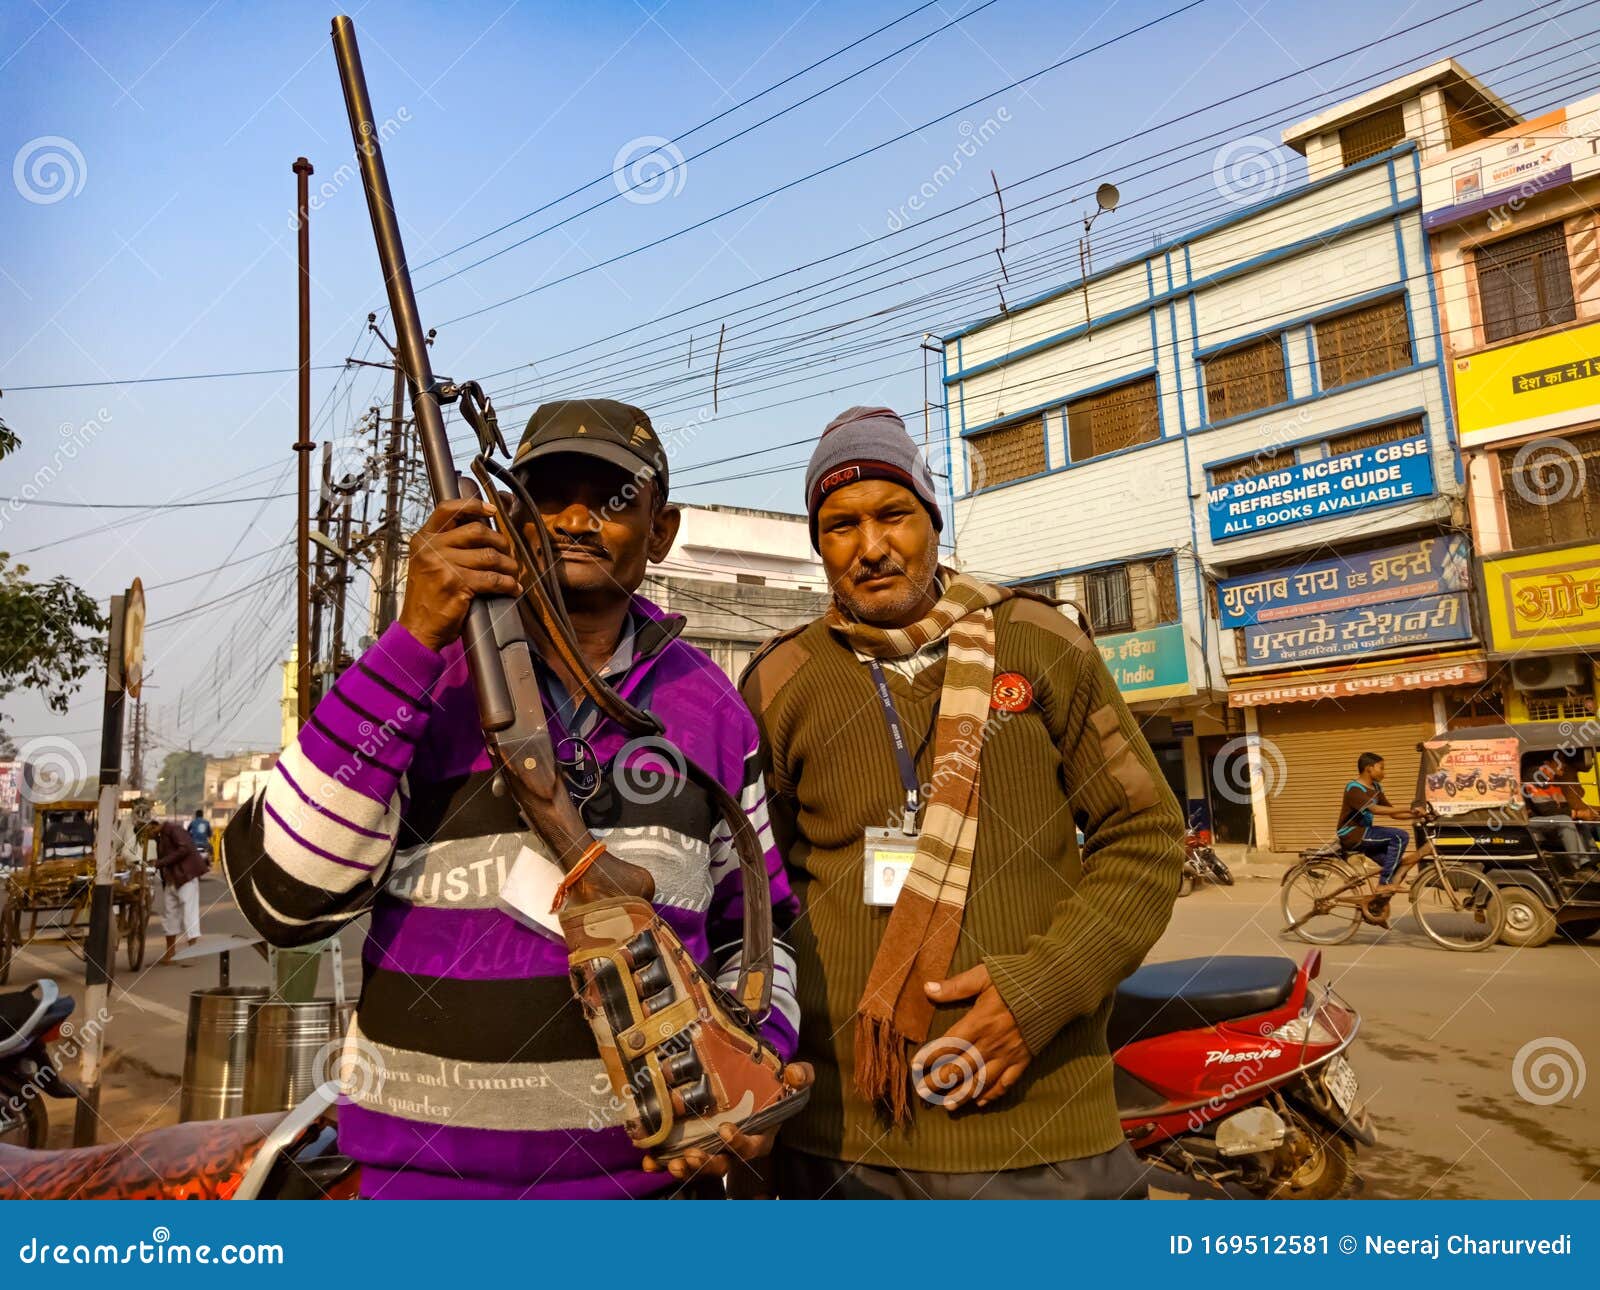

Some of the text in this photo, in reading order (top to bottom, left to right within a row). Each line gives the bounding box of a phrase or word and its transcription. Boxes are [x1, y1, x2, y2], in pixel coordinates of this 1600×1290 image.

[1207, 439, 1428, 503] MP BOARD NCERT CBSE
[1229, 465, 1402, 516] REFRESHER GUIDE
[1223, 482, 1414, 534] ALL BOOKS AVALIABLE
[1223, 577, 1289, 617] गुलाब
[1295, 568, 1339, 596] राय
[1369, 539, 1436, 584] ब्रदर्स
[1340, 597, 1461, 638] स्टेशनरी
[1120, 638, 1156, 659] इंडिया
[1123, 665, 1154, 684] India
[417, 1061, 449, 1088] and
[1205, 1049, 1282, 1067] Pleasure
[388, 1095, 452, 1118] quarter
